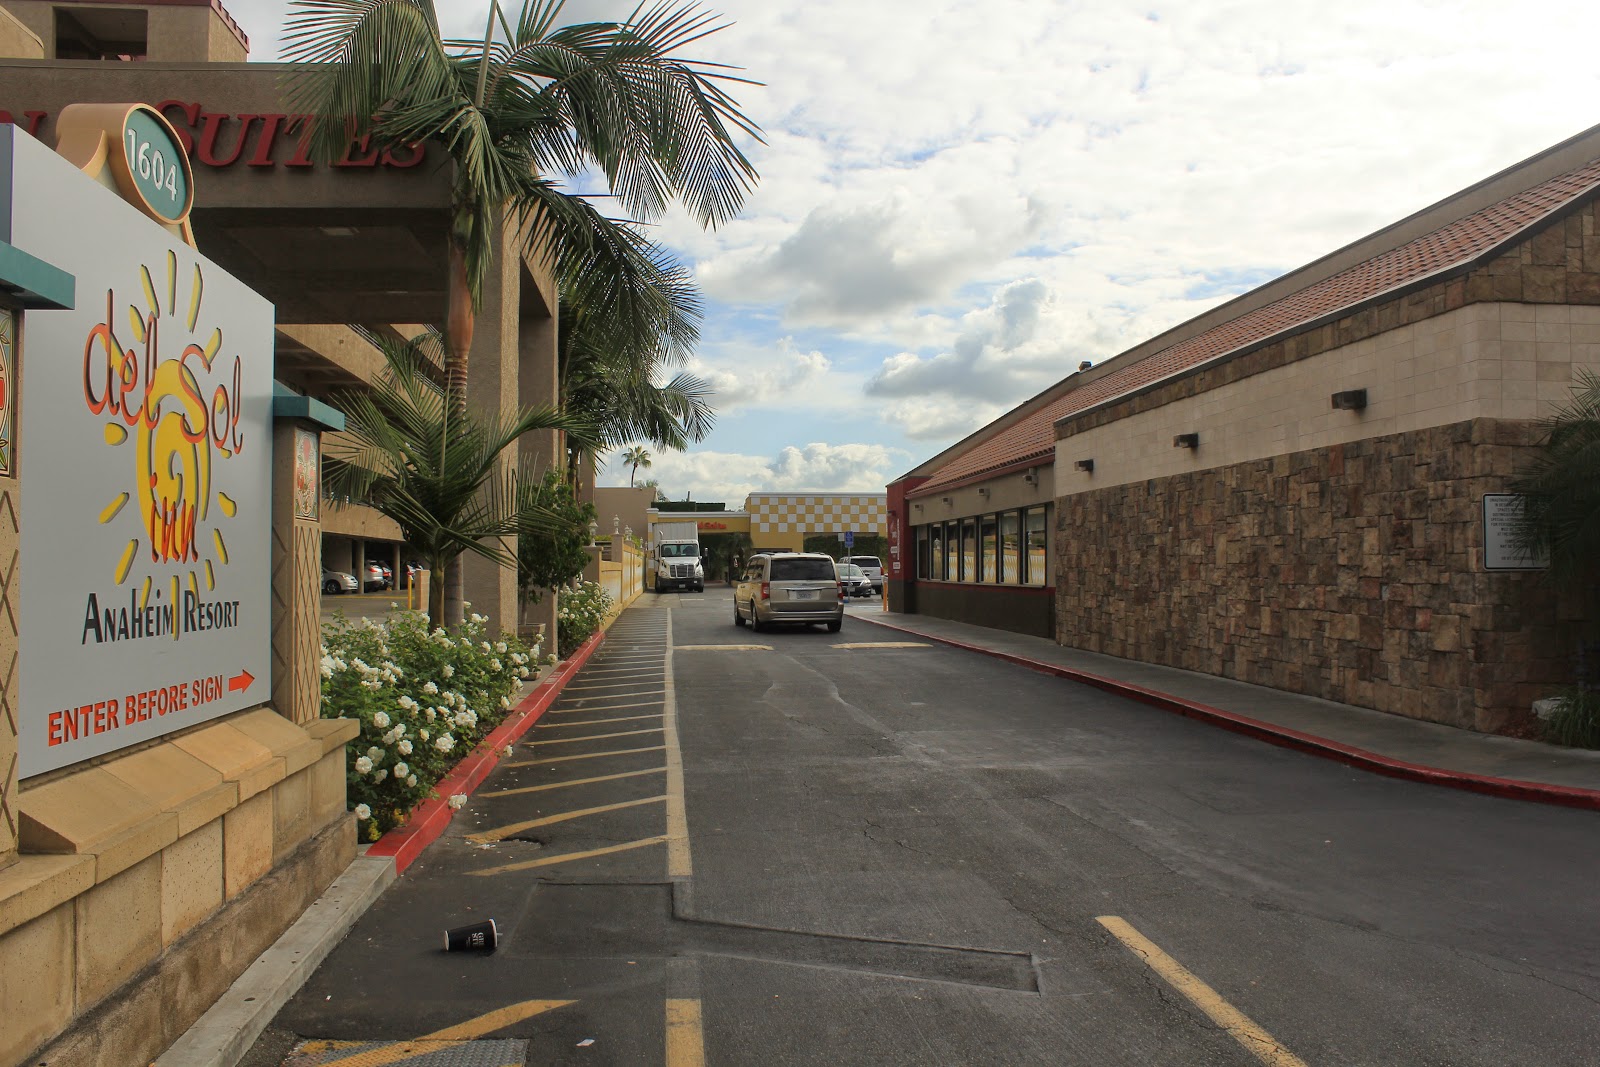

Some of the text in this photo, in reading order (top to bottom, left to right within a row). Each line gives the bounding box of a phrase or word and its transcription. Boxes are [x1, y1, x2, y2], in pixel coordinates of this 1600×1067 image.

[127, 127, 177, 202] 1604
[83, 288, 243, 454] del Sol
[48, 674, 223, 747] ENTER BEFORE SIGN
